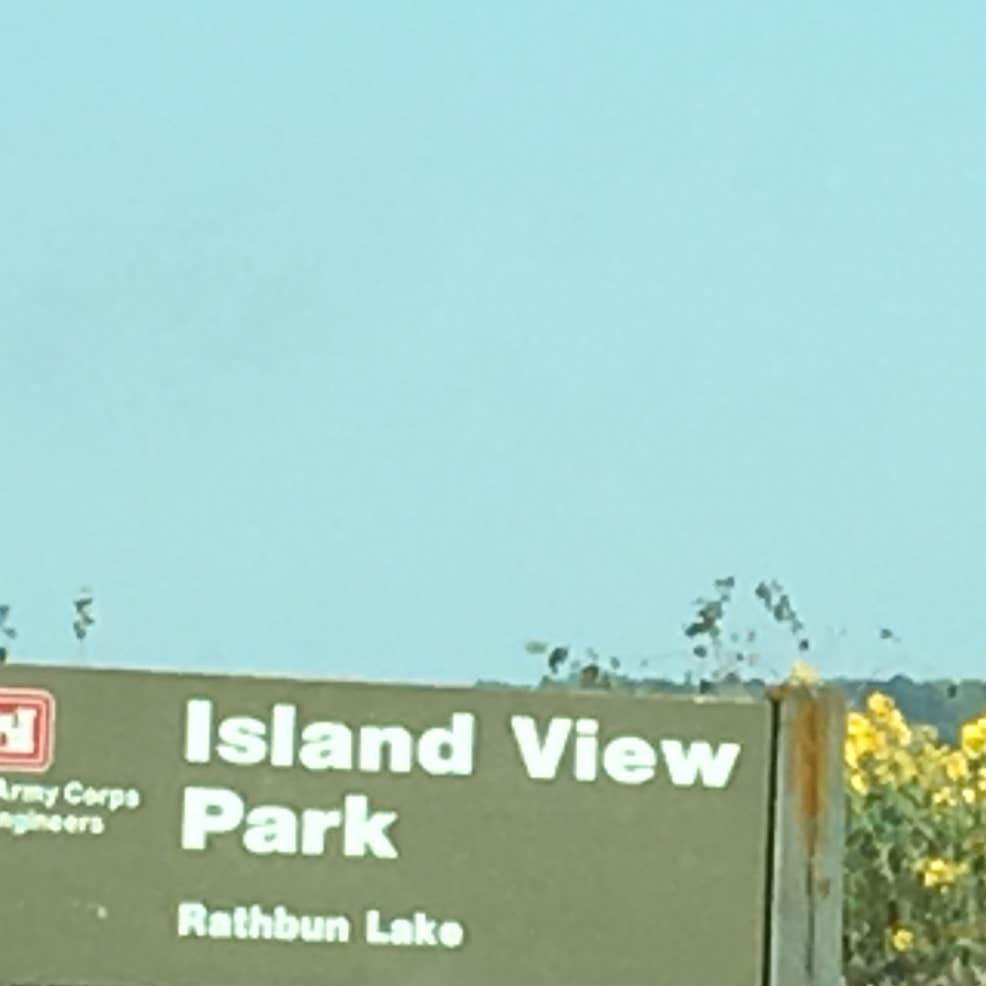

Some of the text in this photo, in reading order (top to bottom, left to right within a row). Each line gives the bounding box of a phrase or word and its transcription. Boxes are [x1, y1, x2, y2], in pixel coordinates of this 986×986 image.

[185, 698, 741, 789] Island View
[63, 780, 140, 812] Corps
[0, 811, 105, 835] ngineers
[181, 785, 398, 859] Park
[177, 902, 464, 949] Rathbun Lake
